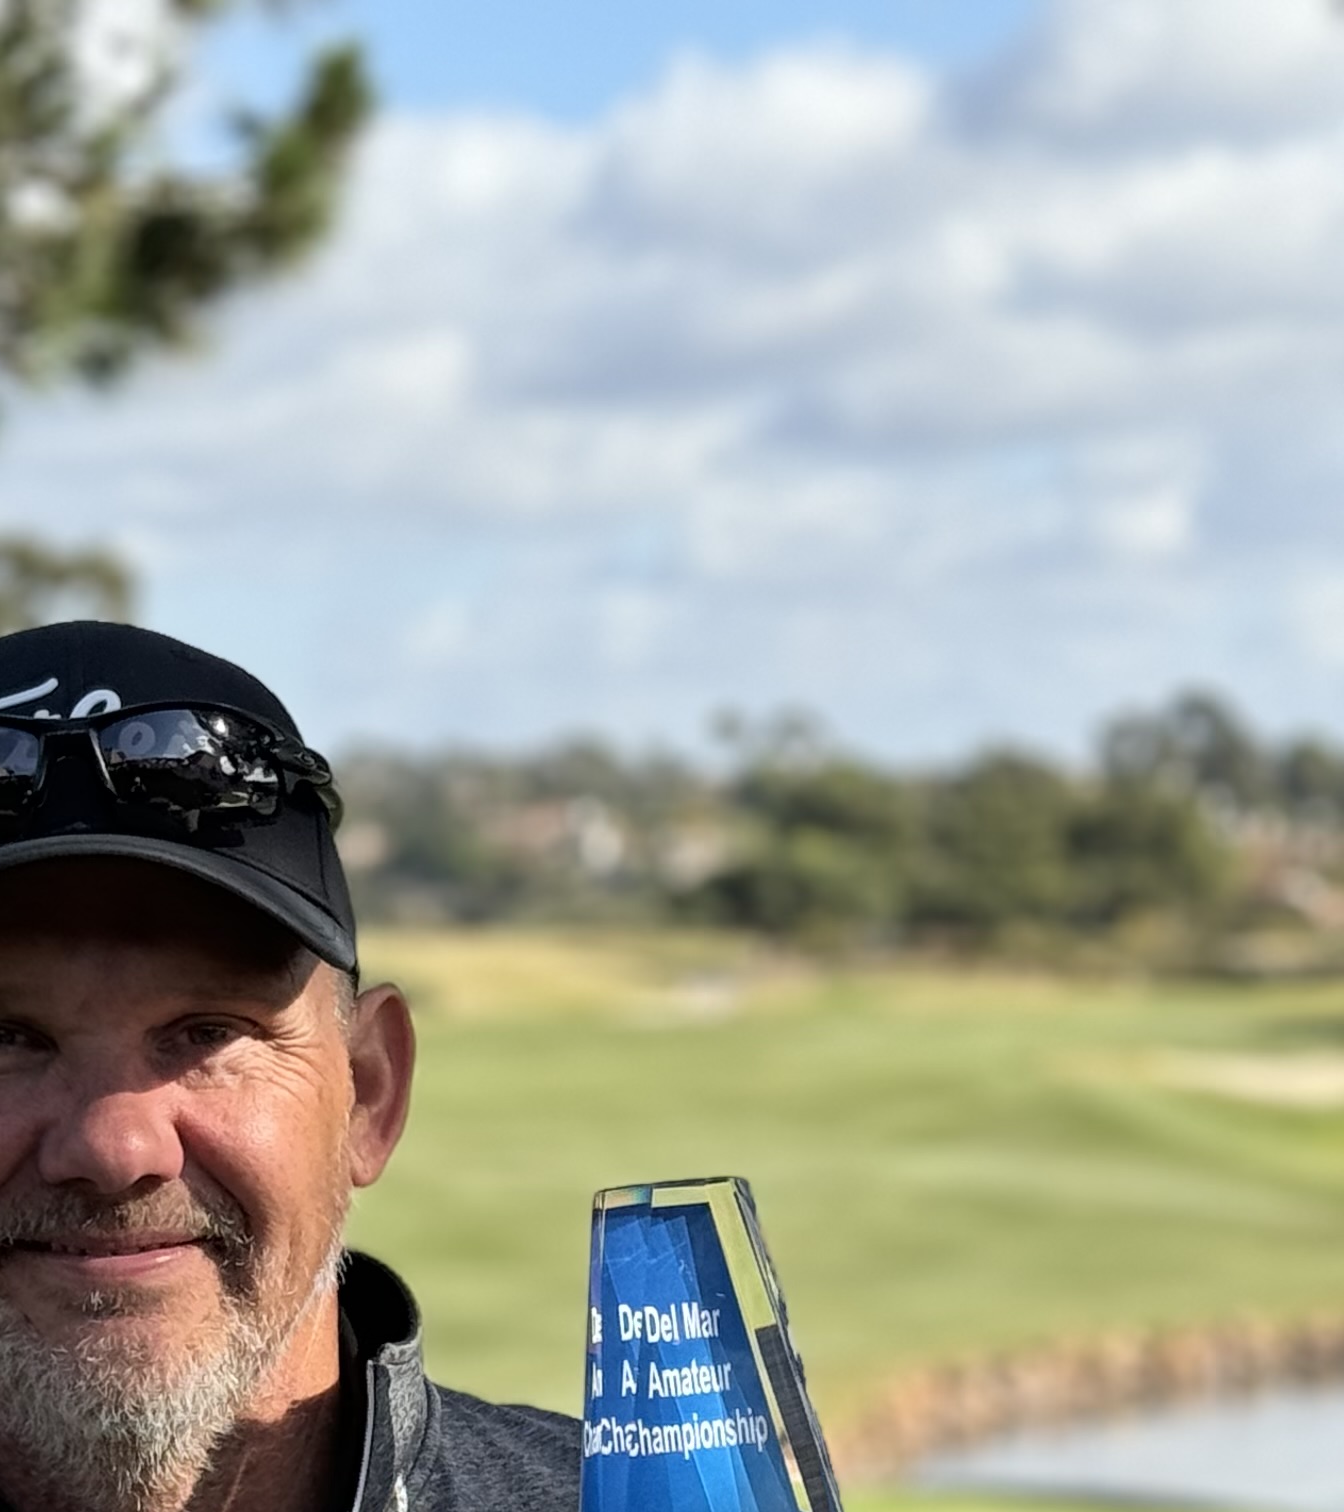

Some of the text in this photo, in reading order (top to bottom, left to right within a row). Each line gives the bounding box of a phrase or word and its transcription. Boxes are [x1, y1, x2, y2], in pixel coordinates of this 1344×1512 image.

[644, 1304, 679, 1343] Del
[681, 1302, 721, 1340] Mar
[648, 1358, 732, 1399] Amateur
[624, 1407, 768, 1461] Championship
